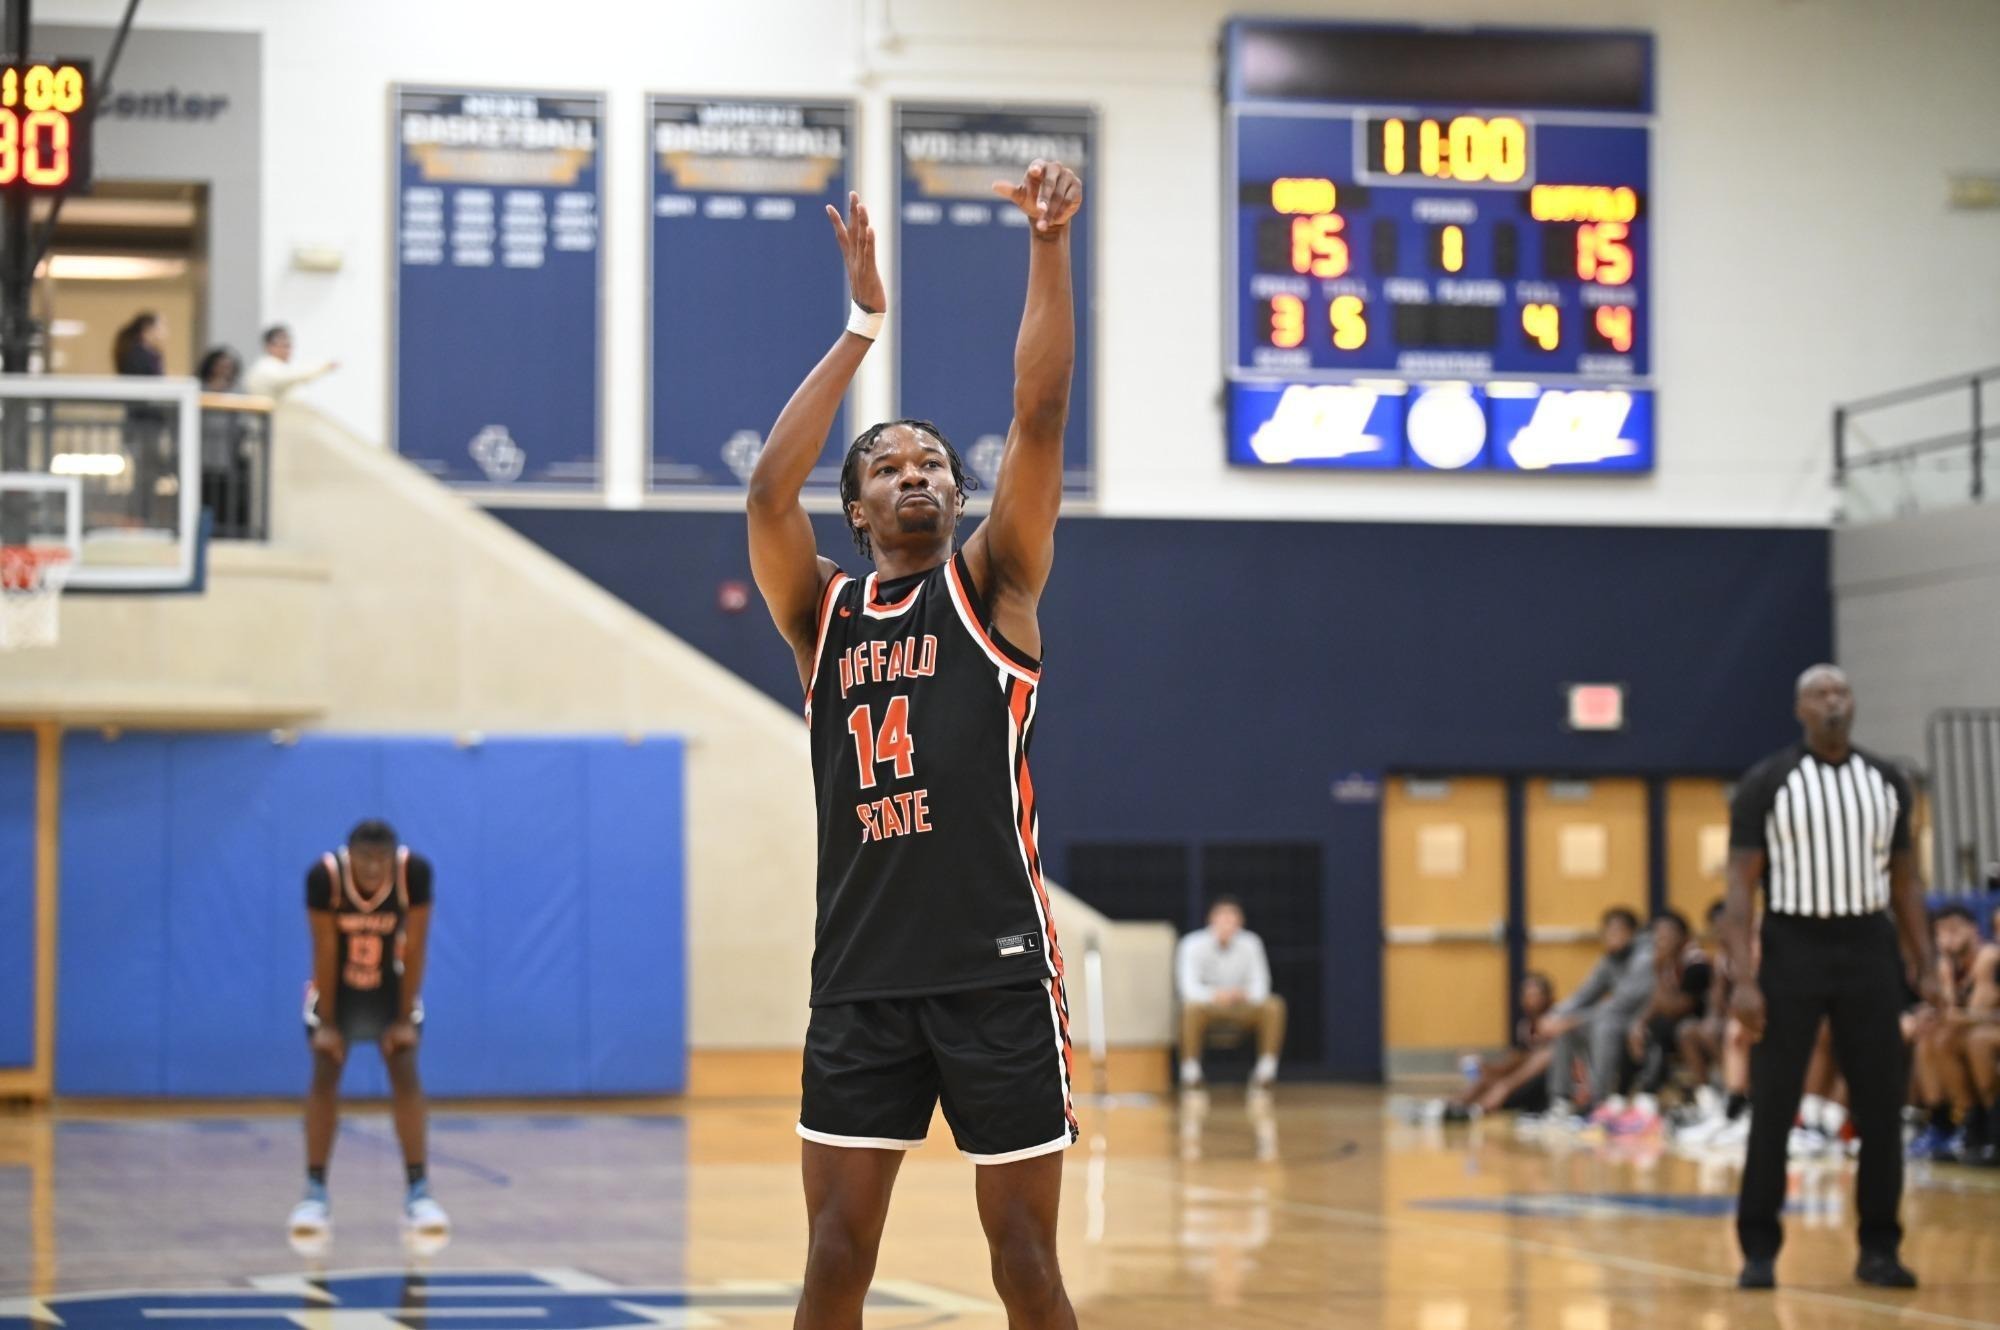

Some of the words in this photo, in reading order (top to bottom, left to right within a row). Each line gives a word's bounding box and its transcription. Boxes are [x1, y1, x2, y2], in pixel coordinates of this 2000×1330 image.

[100, 86, 230, 121] enter
[403, 113, 593, 150] BASKETBALL
[656, 121, 845, 158] BASKETBALL
[1384, 116, 1526, 182] 11:00
[1291, 213, 1349, 278] 15
[1442, 225, 1463, 272] 1
[1576, 222, 1633, 285] 15
[1271, 294, 1305, 348] 3
[1329, 295, 1367, 350] 5
[1522, 303, 1559, 351] 4
[1595, 305, 1632, 352] 4
[848, 695, 914, 790] 14
[856, 789, 932, 844] STATE
[1028, 937, 1035, 948] L
